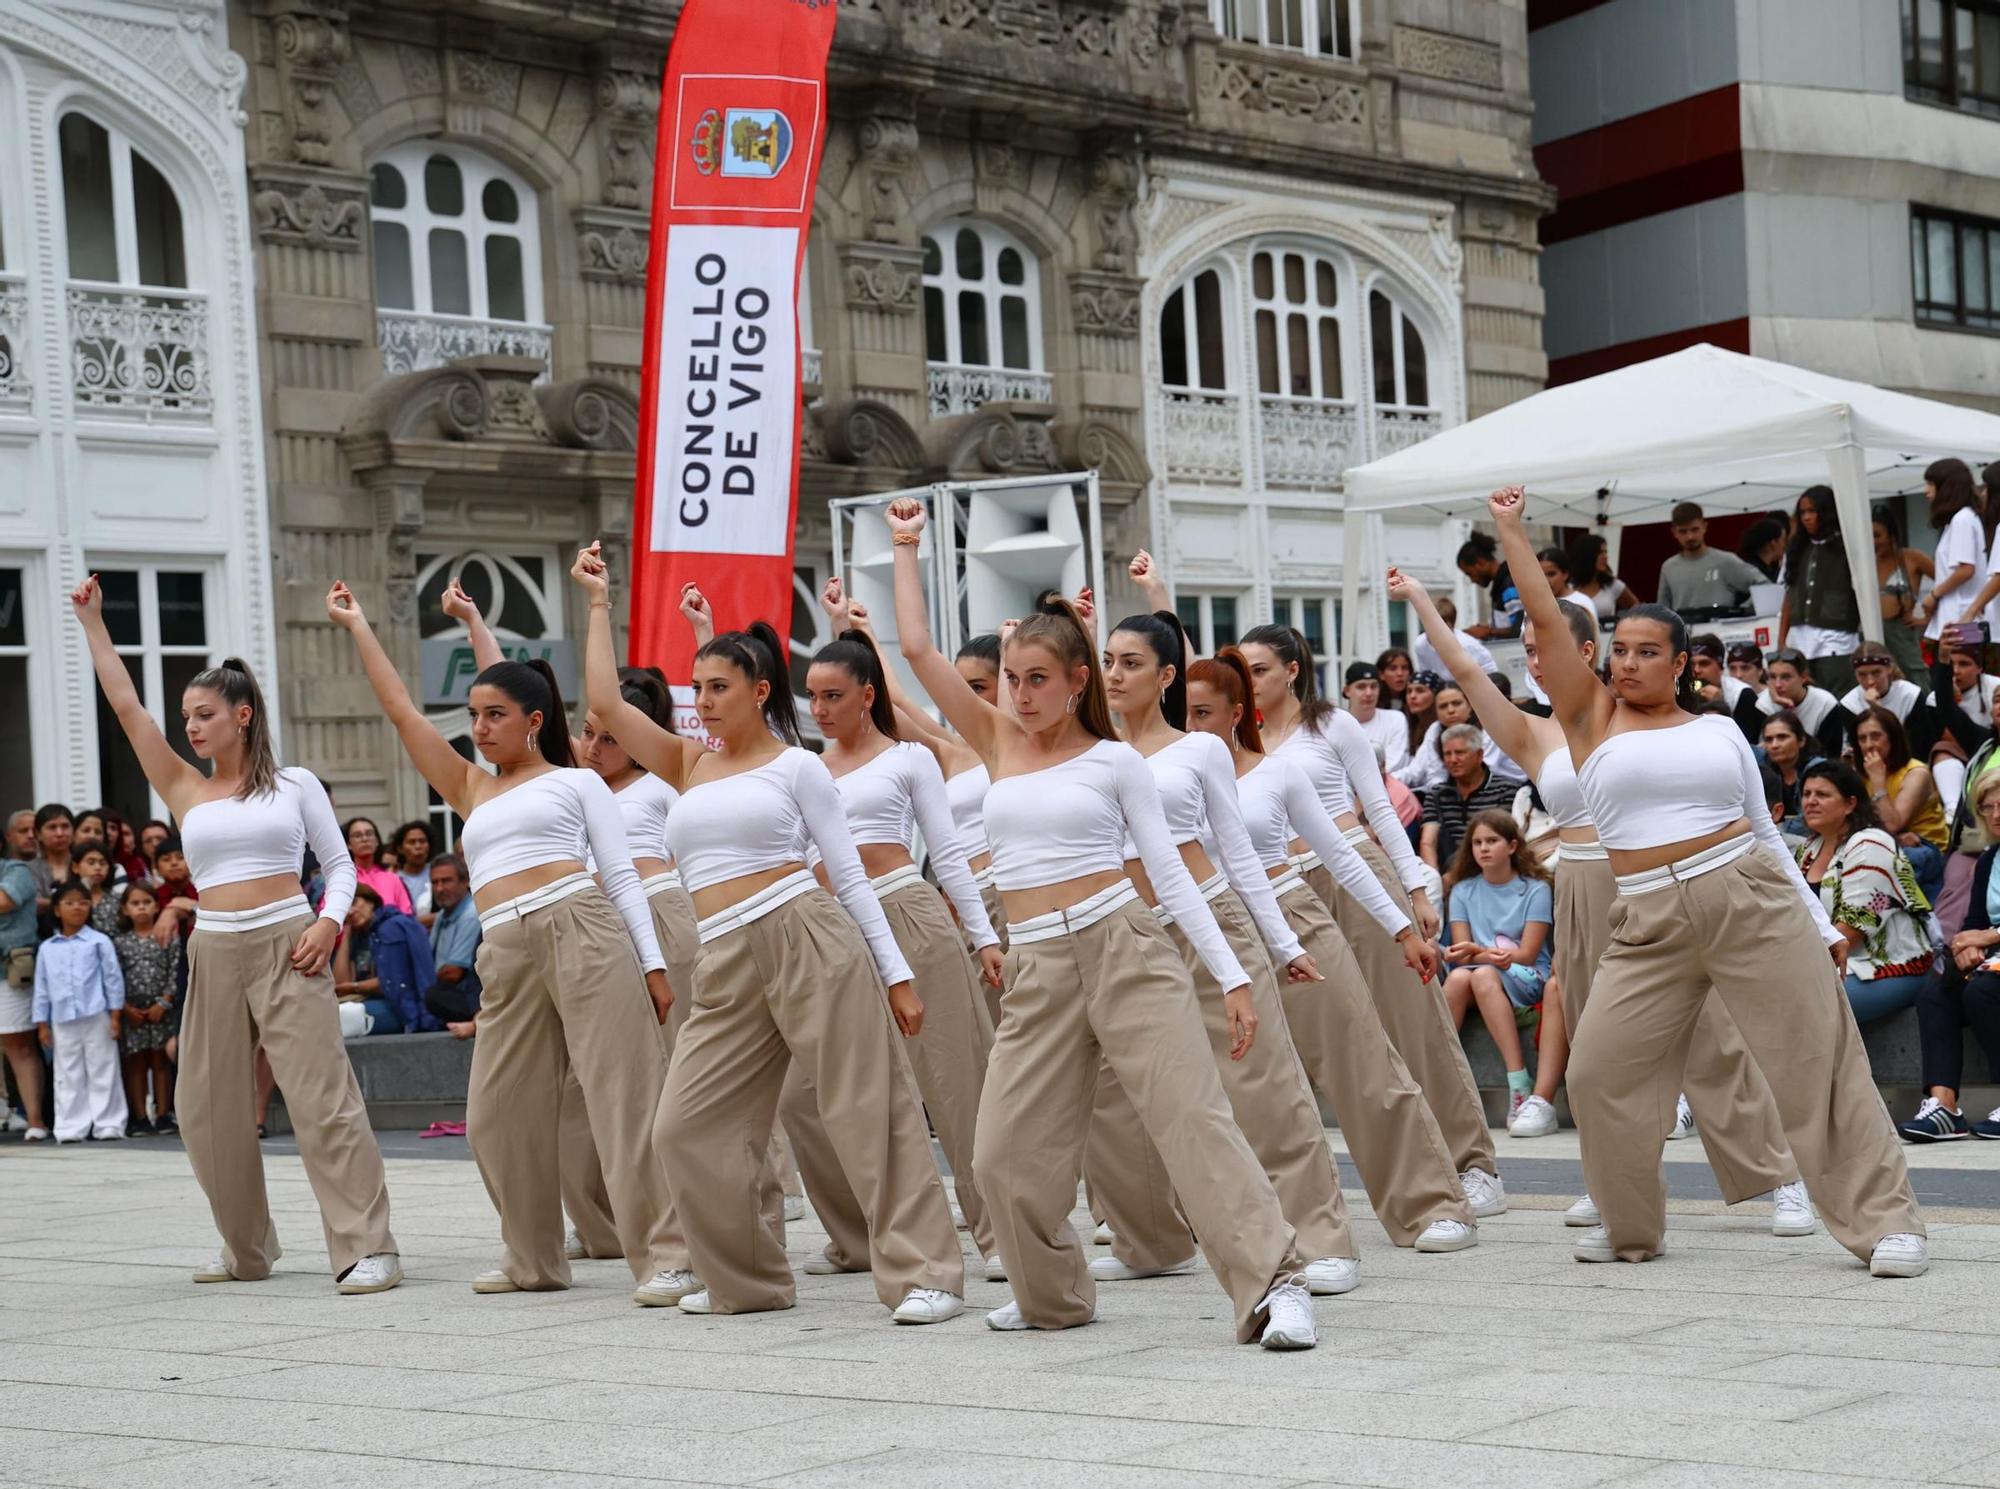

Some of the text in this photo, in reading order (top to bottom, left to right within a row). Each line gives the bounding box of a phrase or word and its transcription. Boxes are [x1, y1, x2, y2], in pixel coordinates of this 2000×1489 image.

[679, 253, 727, 527] CONCELLO
[722, 287, 770, 495] DE VIGO
